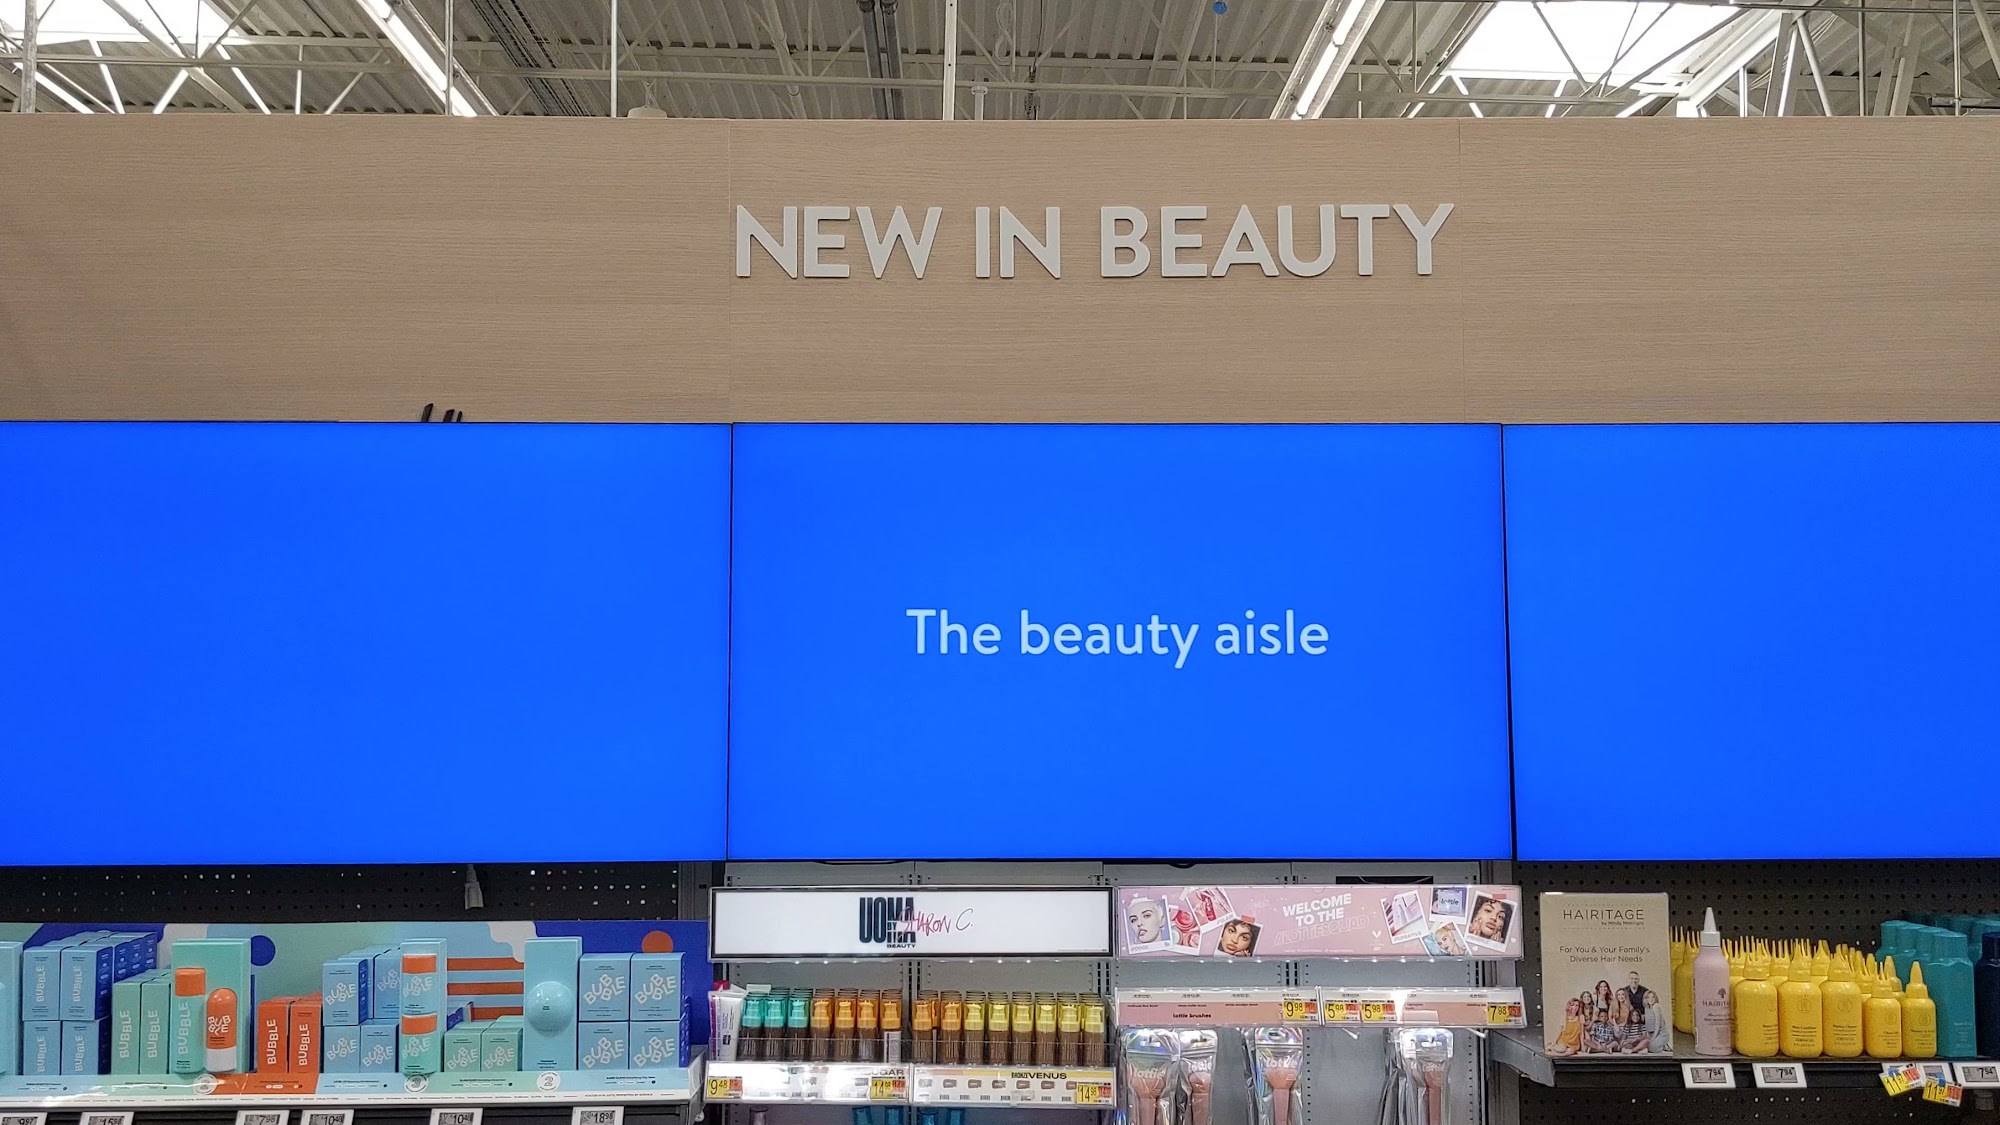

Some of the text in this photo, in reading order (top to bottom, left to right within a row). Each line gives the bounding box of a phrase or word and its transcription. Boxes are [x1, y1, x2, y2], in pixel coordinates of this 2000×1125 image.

[734, 202, 1455, 278] NEW IN BEAUTY
[906, 609, 1330, 669] The beauty aisle
[1282, 892, 1352, 917] WELCOME
[1296, 907, 1345, 927] TO THE
[1563, 909, 1644, 920] HAIRITAGE
[887, 922, 897, 931] BY
[1560, 946, 1650, 955] For You & Your Family's
[36, 965, 46, 1002] BUBBLE
[325, 982, 357, 1006] BUBBLE
[377, 969, 400, 992] BUBB
[402, 975, 433, 998] BUBBLE
[583, 973, 626, 1005] BUBBLE
[634, 973, 677, 1005] BUBBLE
[119, 1010, 132, 1058] BUBBLE
[147, 1010, 160, 1058] BUBBLE
[178, 1002, 191, 1055] BUBBLE
[266, 1018, 279, 1065] BUBBLE
[75, 1034, 85, 1071] BUBBLE
[299, 1023, 310, 1066] BUBBLE
[326, 1037, 357, 1061] BUBBLE
[362, 1044, 394, 1067] BUBBLE
[447, 1046, 478, 1070] BUBBLE
[484, 1046, 515, 1070] BUBBLE
[583, 1037, 625, 1068] BUBBLE
[633, 1036, 675, 1068] BUBBLE
[544, 1077, 553, 1087] 2
